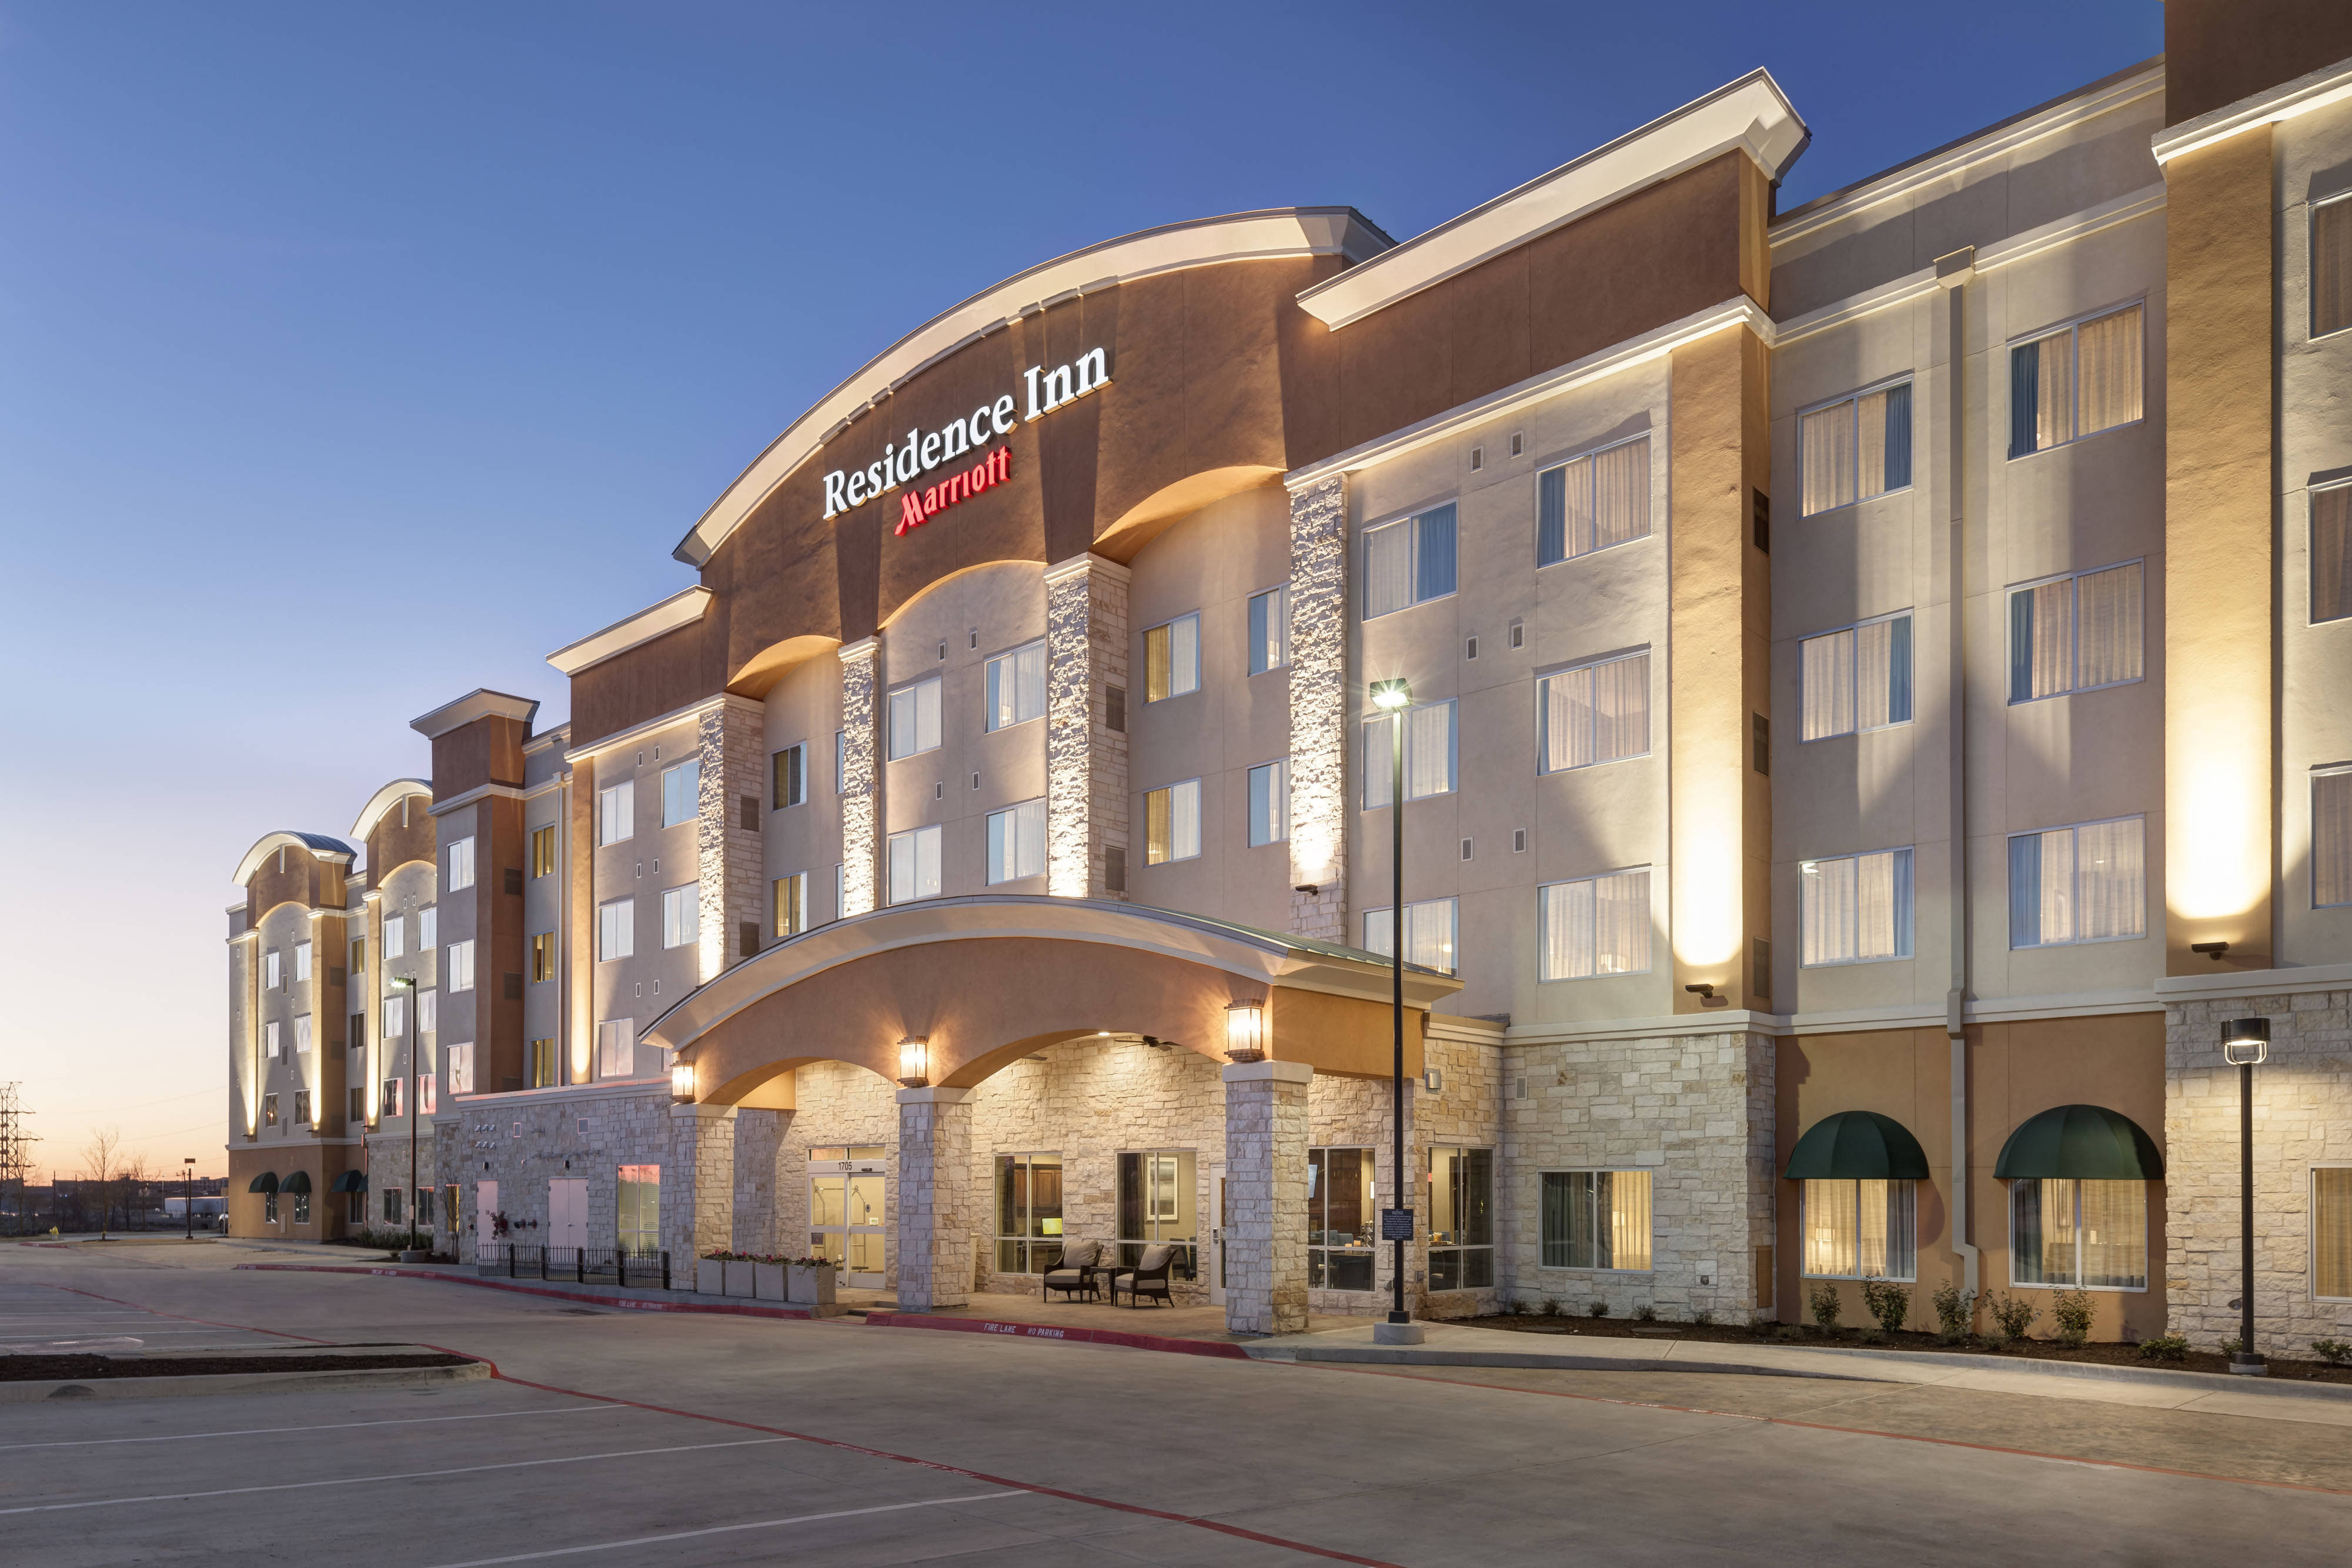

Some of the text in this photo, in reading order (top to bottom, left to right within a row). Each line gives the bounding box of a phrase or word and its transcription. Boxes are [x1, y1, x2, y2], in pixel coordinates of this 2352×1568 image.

[823, 347, 1112, 521] Residence Inn
[894, 445, 1012, 537] Marriott
[838, 1161, 852, 1171] 1705
[984, 1323, 998, 1331] FIRE
[1000, 1325, 1016, 1333] LANE
[1037, 1328, 1064, 1338] PARKING
